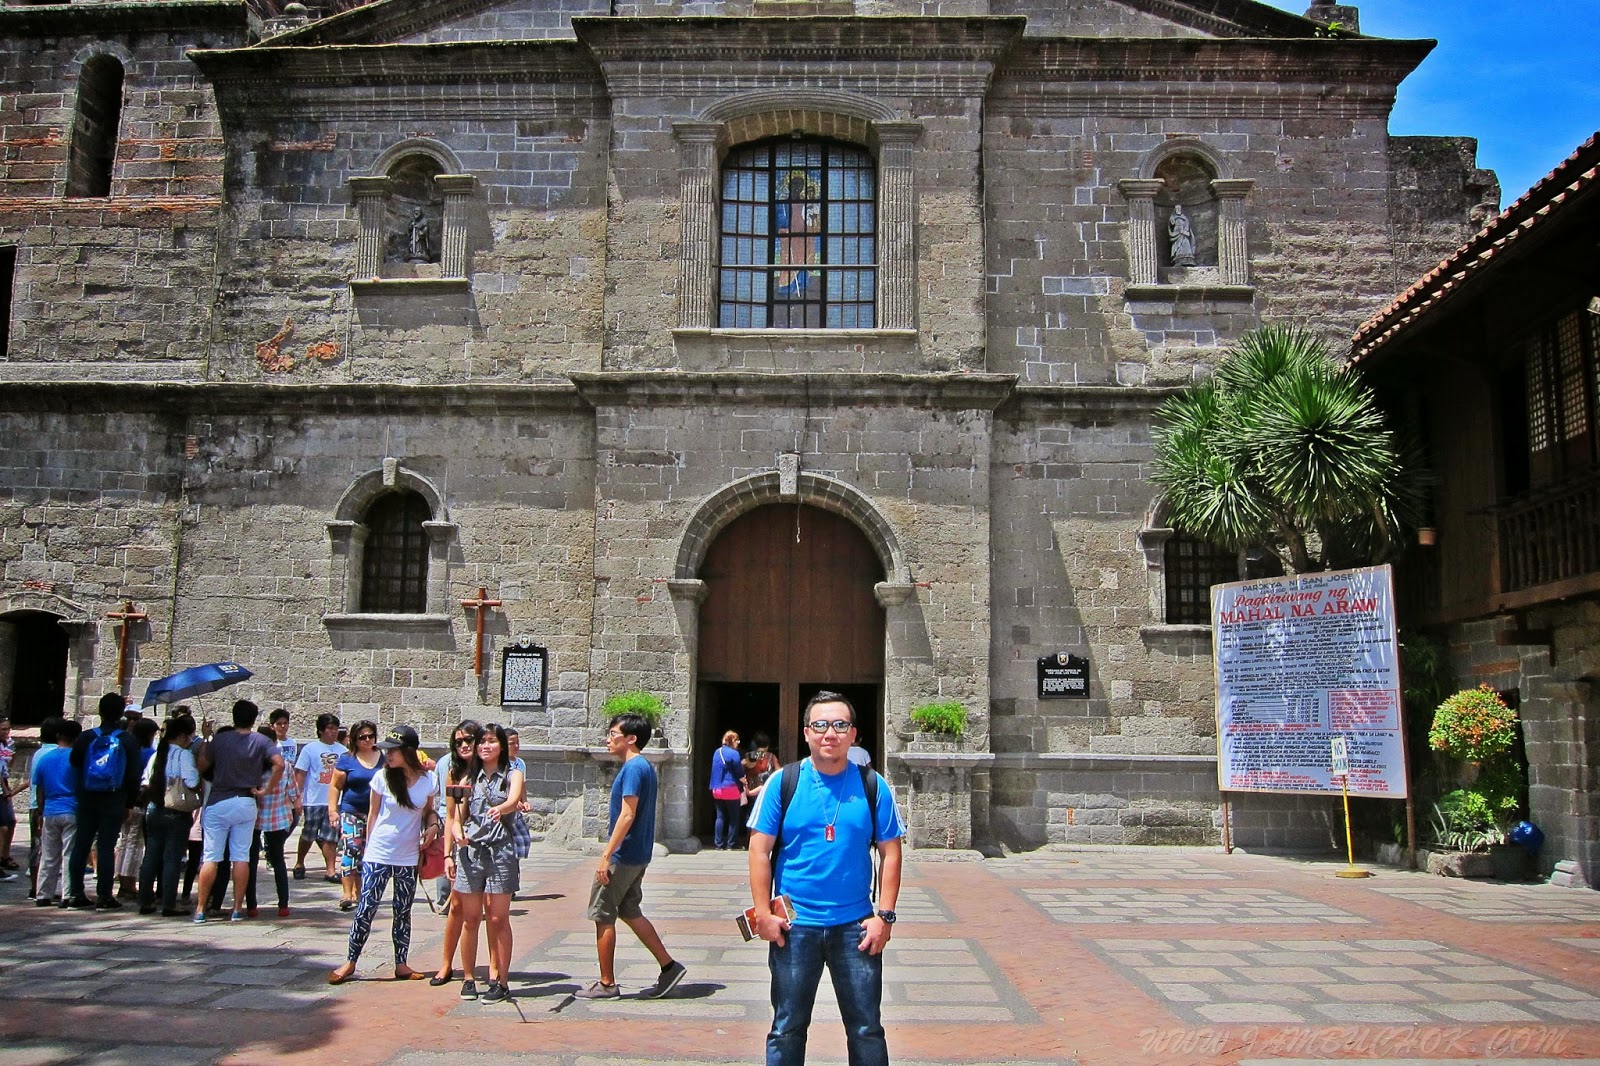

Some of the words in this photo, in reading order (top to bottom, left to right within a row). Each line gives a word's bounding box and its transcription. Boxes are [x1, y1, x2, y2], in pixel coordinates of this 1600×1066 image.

[1242, 581, 1282, 592] PAROKYA
[1302, 576, 1323, 585] SAN
[1327, 573, 1354, 583] JOSE
[1232, 590, 1323, 608] Pagdiriwang
[1219, 606, 1285, 625] MAHAL
[1290, 603, 1316, 618] NA
[1321, 597, 1379, 615] ARAW
